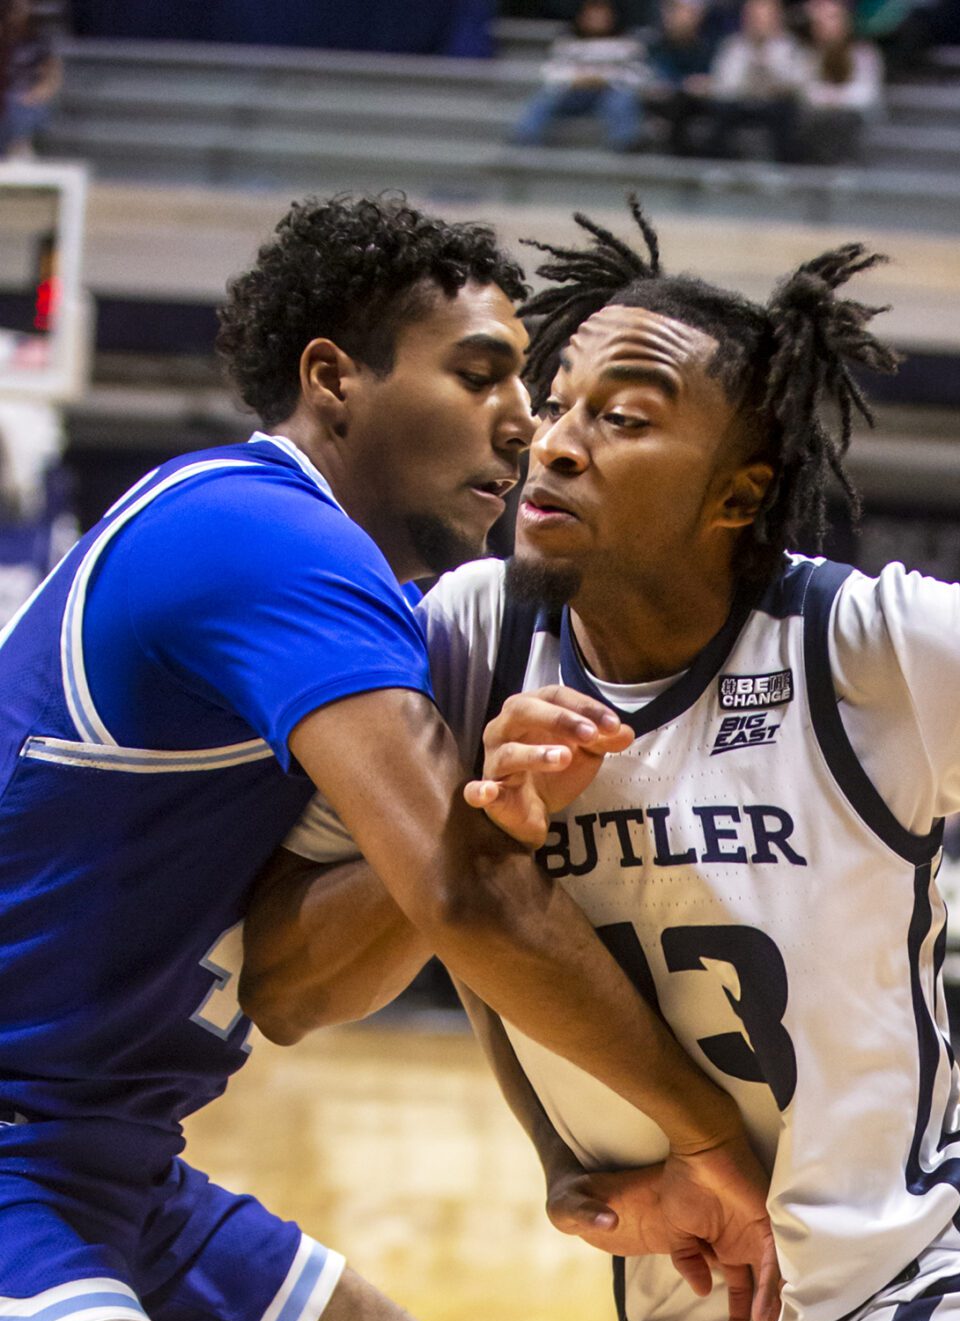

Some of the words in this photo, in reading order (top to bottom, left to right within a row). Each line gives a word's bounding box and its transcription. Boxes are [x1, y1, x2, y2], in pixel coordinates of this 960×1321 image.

[722, 687, 791, 707] CHANGE
[720, 712, 768, 731] BIG
[714, 724, 780, 747] EAST
[535, 804, 808, 878] BUTLER
